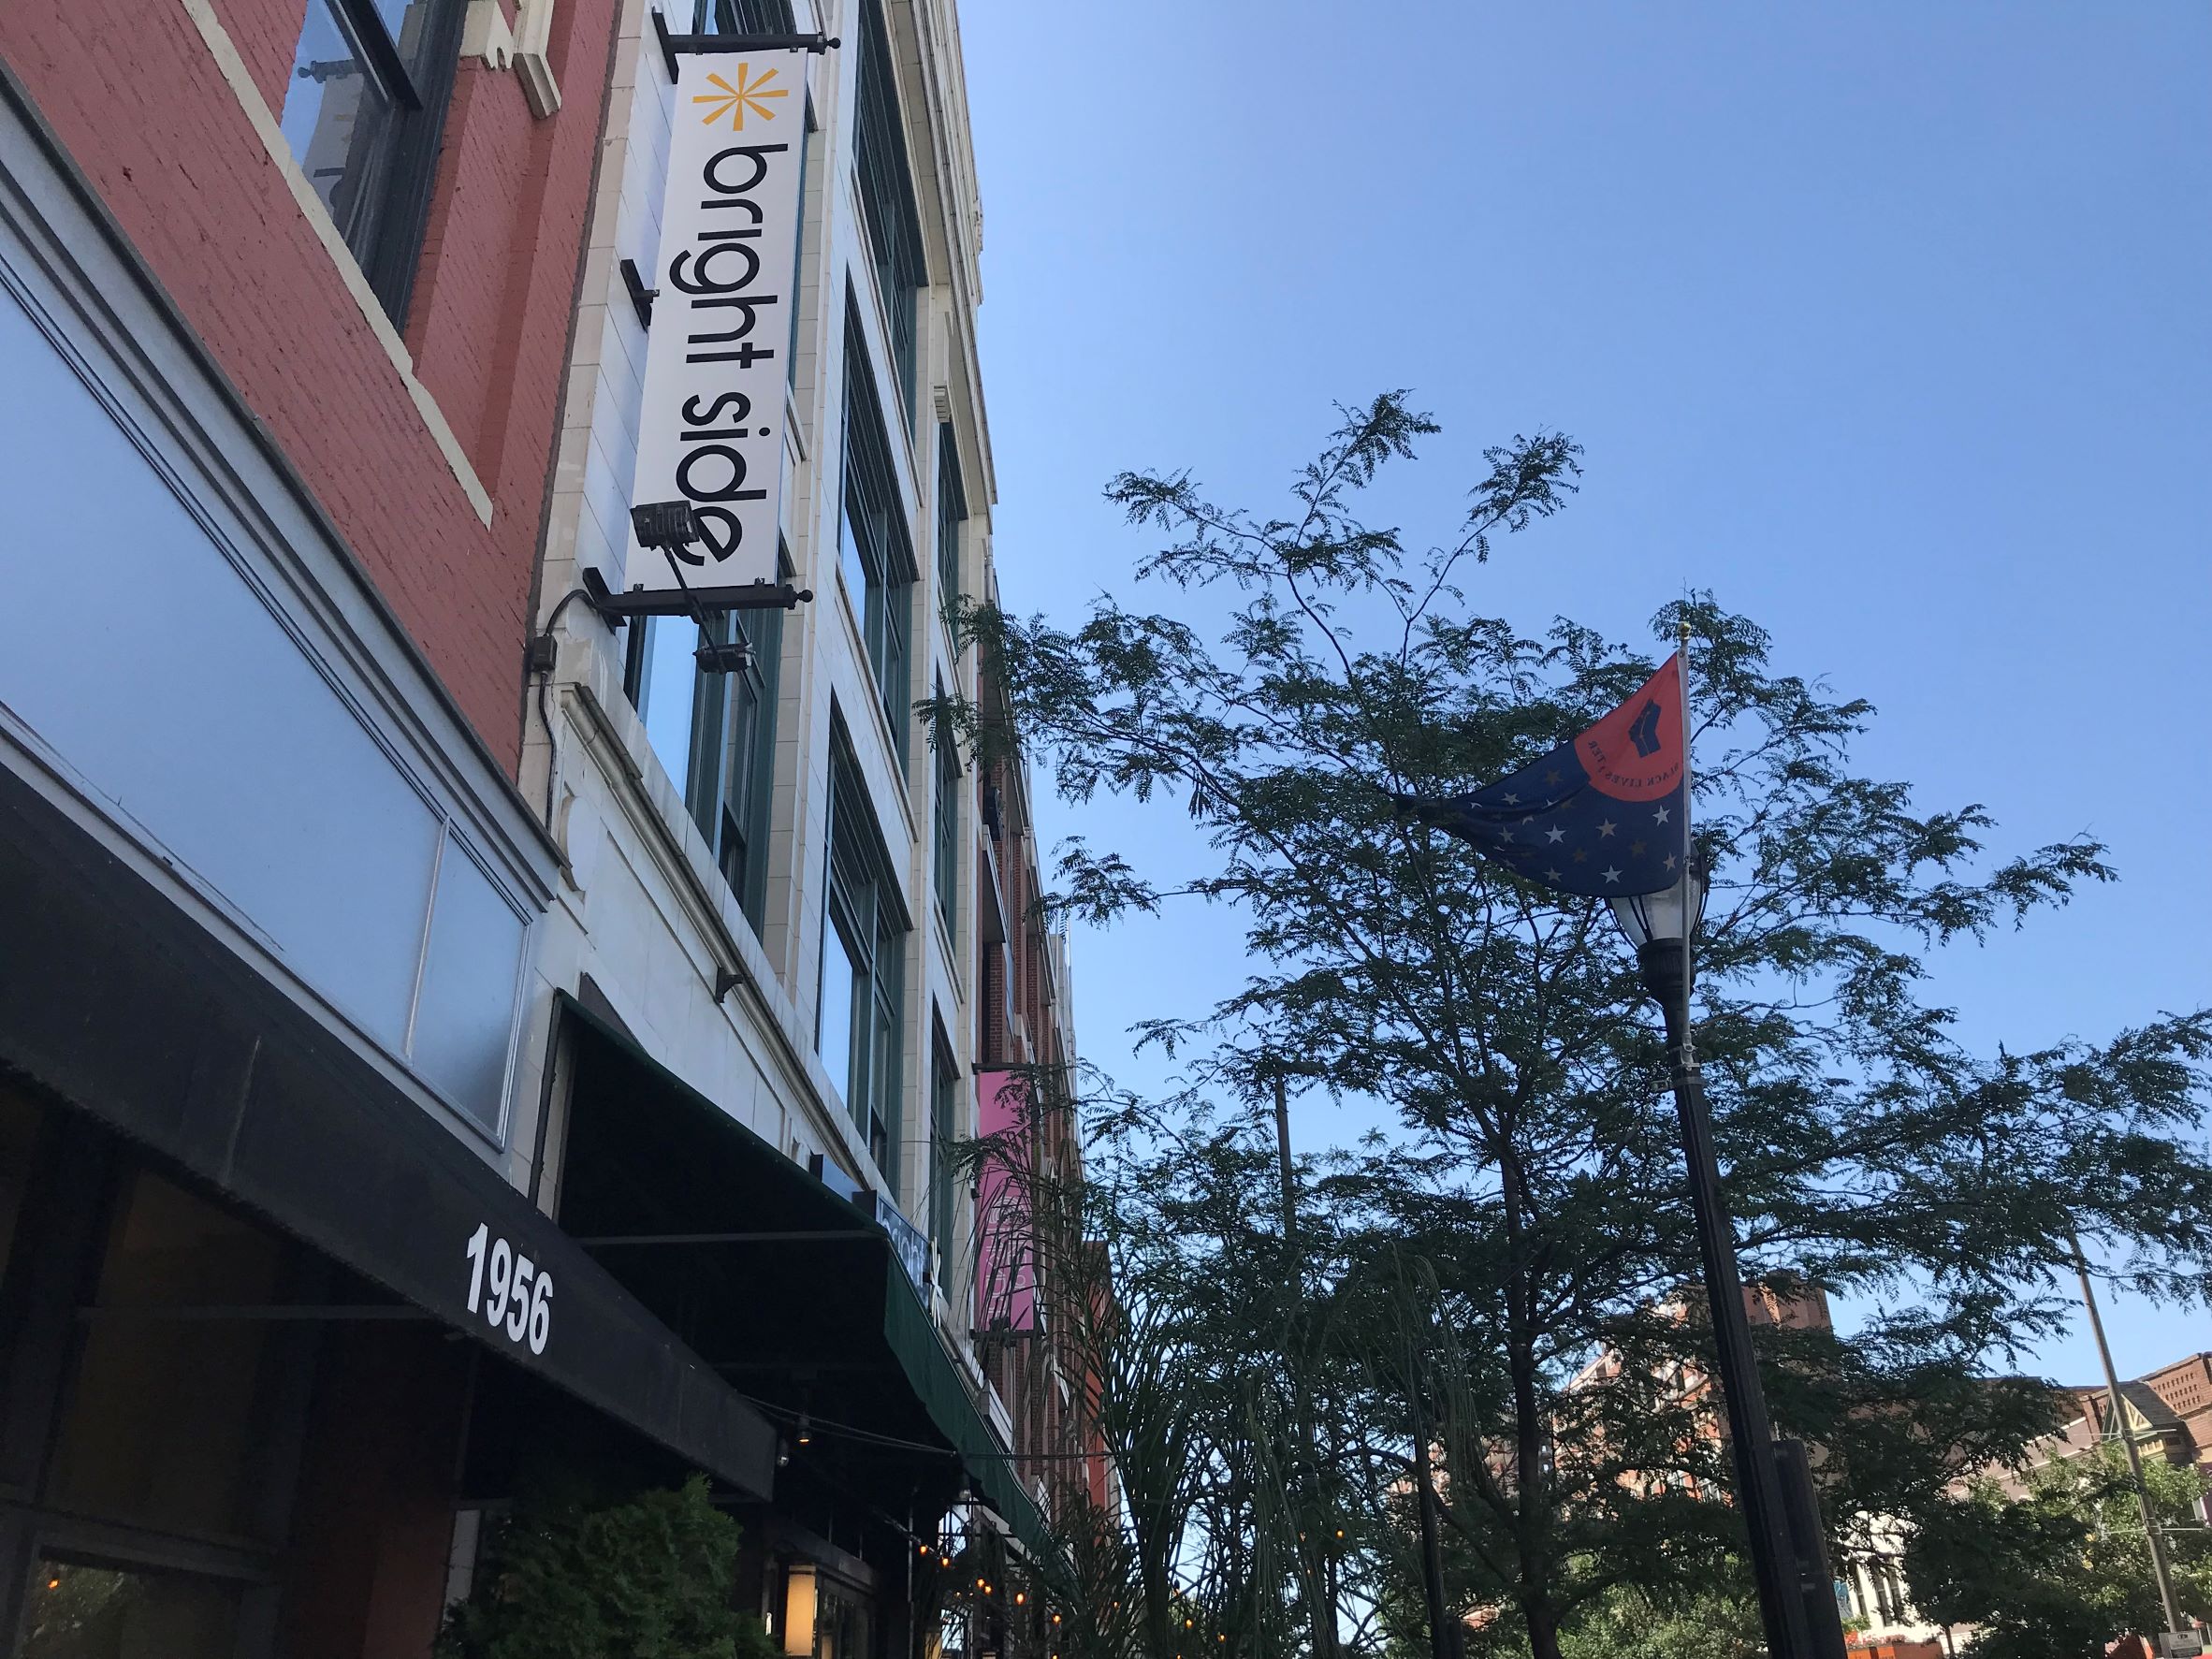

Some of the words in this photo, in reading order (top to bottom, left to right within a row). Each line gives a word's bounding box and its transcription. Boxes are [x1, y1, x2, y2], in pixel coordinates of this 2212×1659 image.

[669, 142, 789, 370] bright
[671, 391, 771, 568] side
[467, 1222, 554, 1355] 1956
